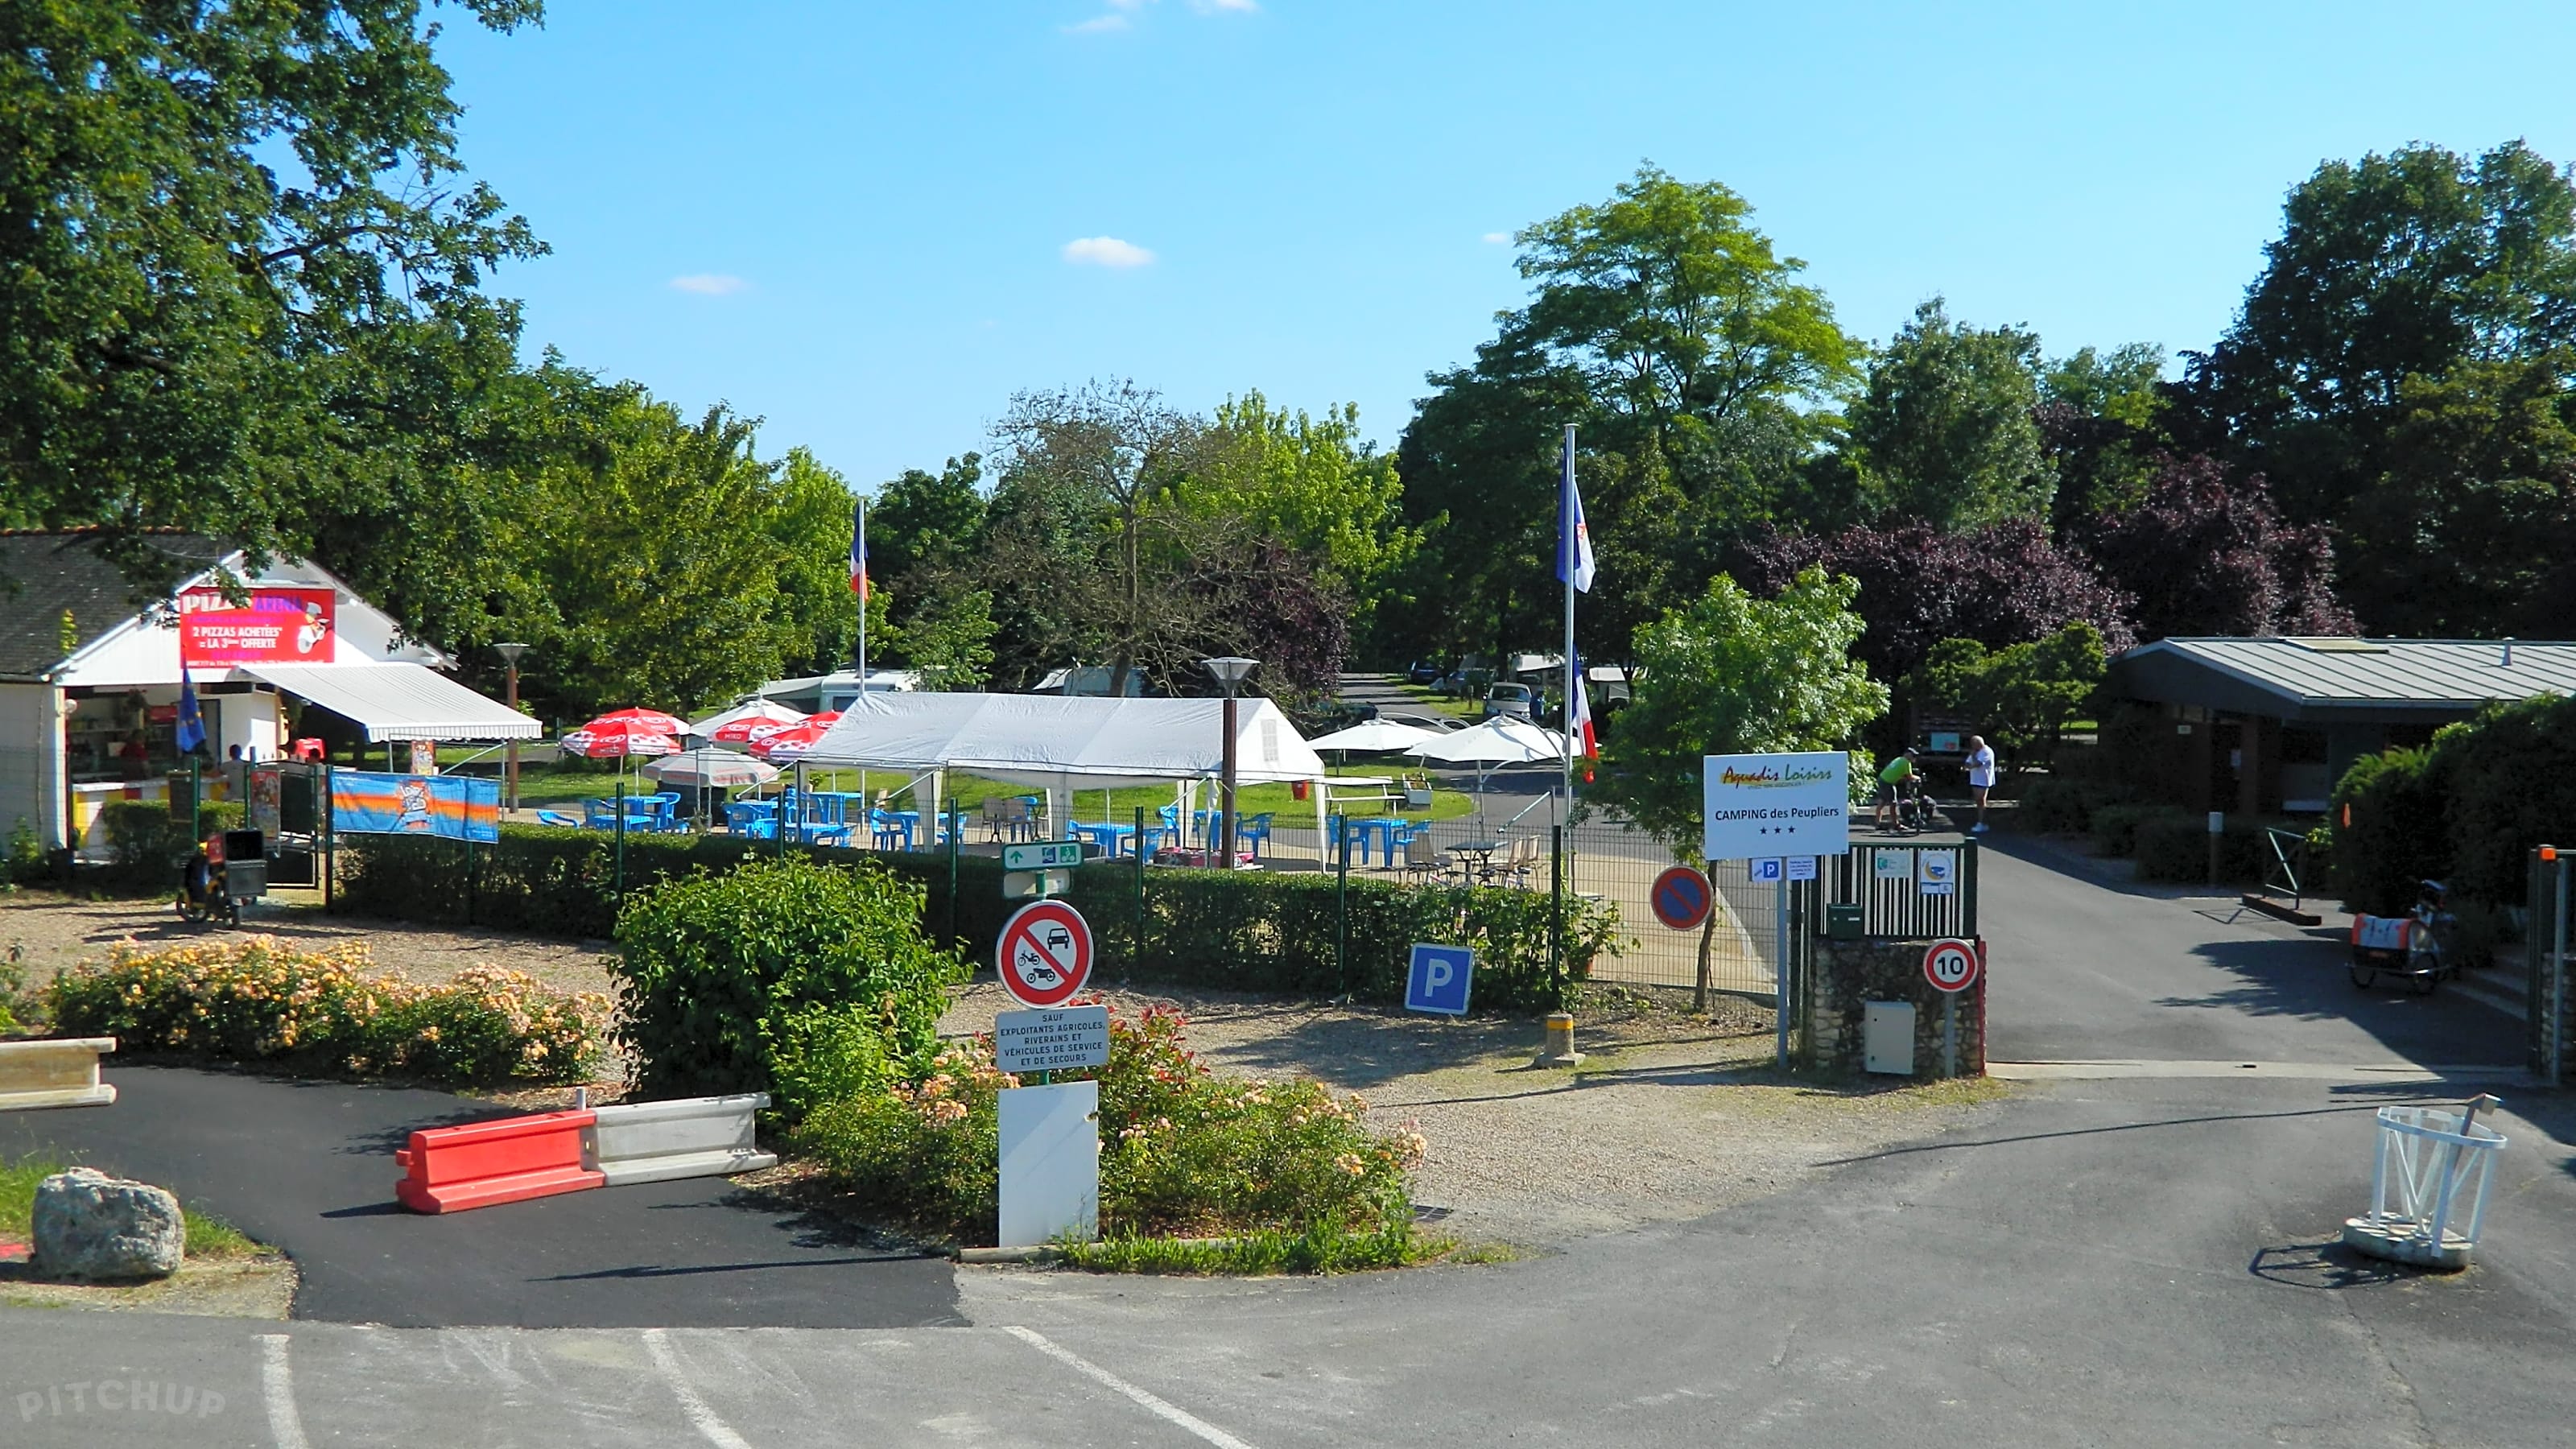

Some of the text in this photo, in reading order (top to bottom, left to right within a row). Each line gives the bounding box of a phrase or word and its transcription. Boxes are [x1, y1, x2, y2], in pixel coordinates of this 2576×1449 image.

[193, 627, 200, 637] 2
[201, 627, 235, 637] PIZZAS
[207, 638, 219, 648] LA
[241, 638, 276, 648] OFFERTE
[1723, 764, 1832, 789] Aquadis Loisirs
[1715, 807, 1839, 821] CAMPING des Peupliers
[1767, 864, 1775, 876] P
[1938, 956, 1964, 975] 10
[1424, 958, 1453, 997] P
[1042, 1013, 1063, 1022] SAUF
[1001, 1022, 1105, 1036] EXPLOITANTS AGRICOLES,
[1024, 1034, 1068, 1044] RIVERAINS
[1005, 1042, 1102, 1056] VÉHICULES DE SERVICE
[1021, 1058, 1030, 1066] ET
[1049, 1054, 1086, 1064] SECOURS
